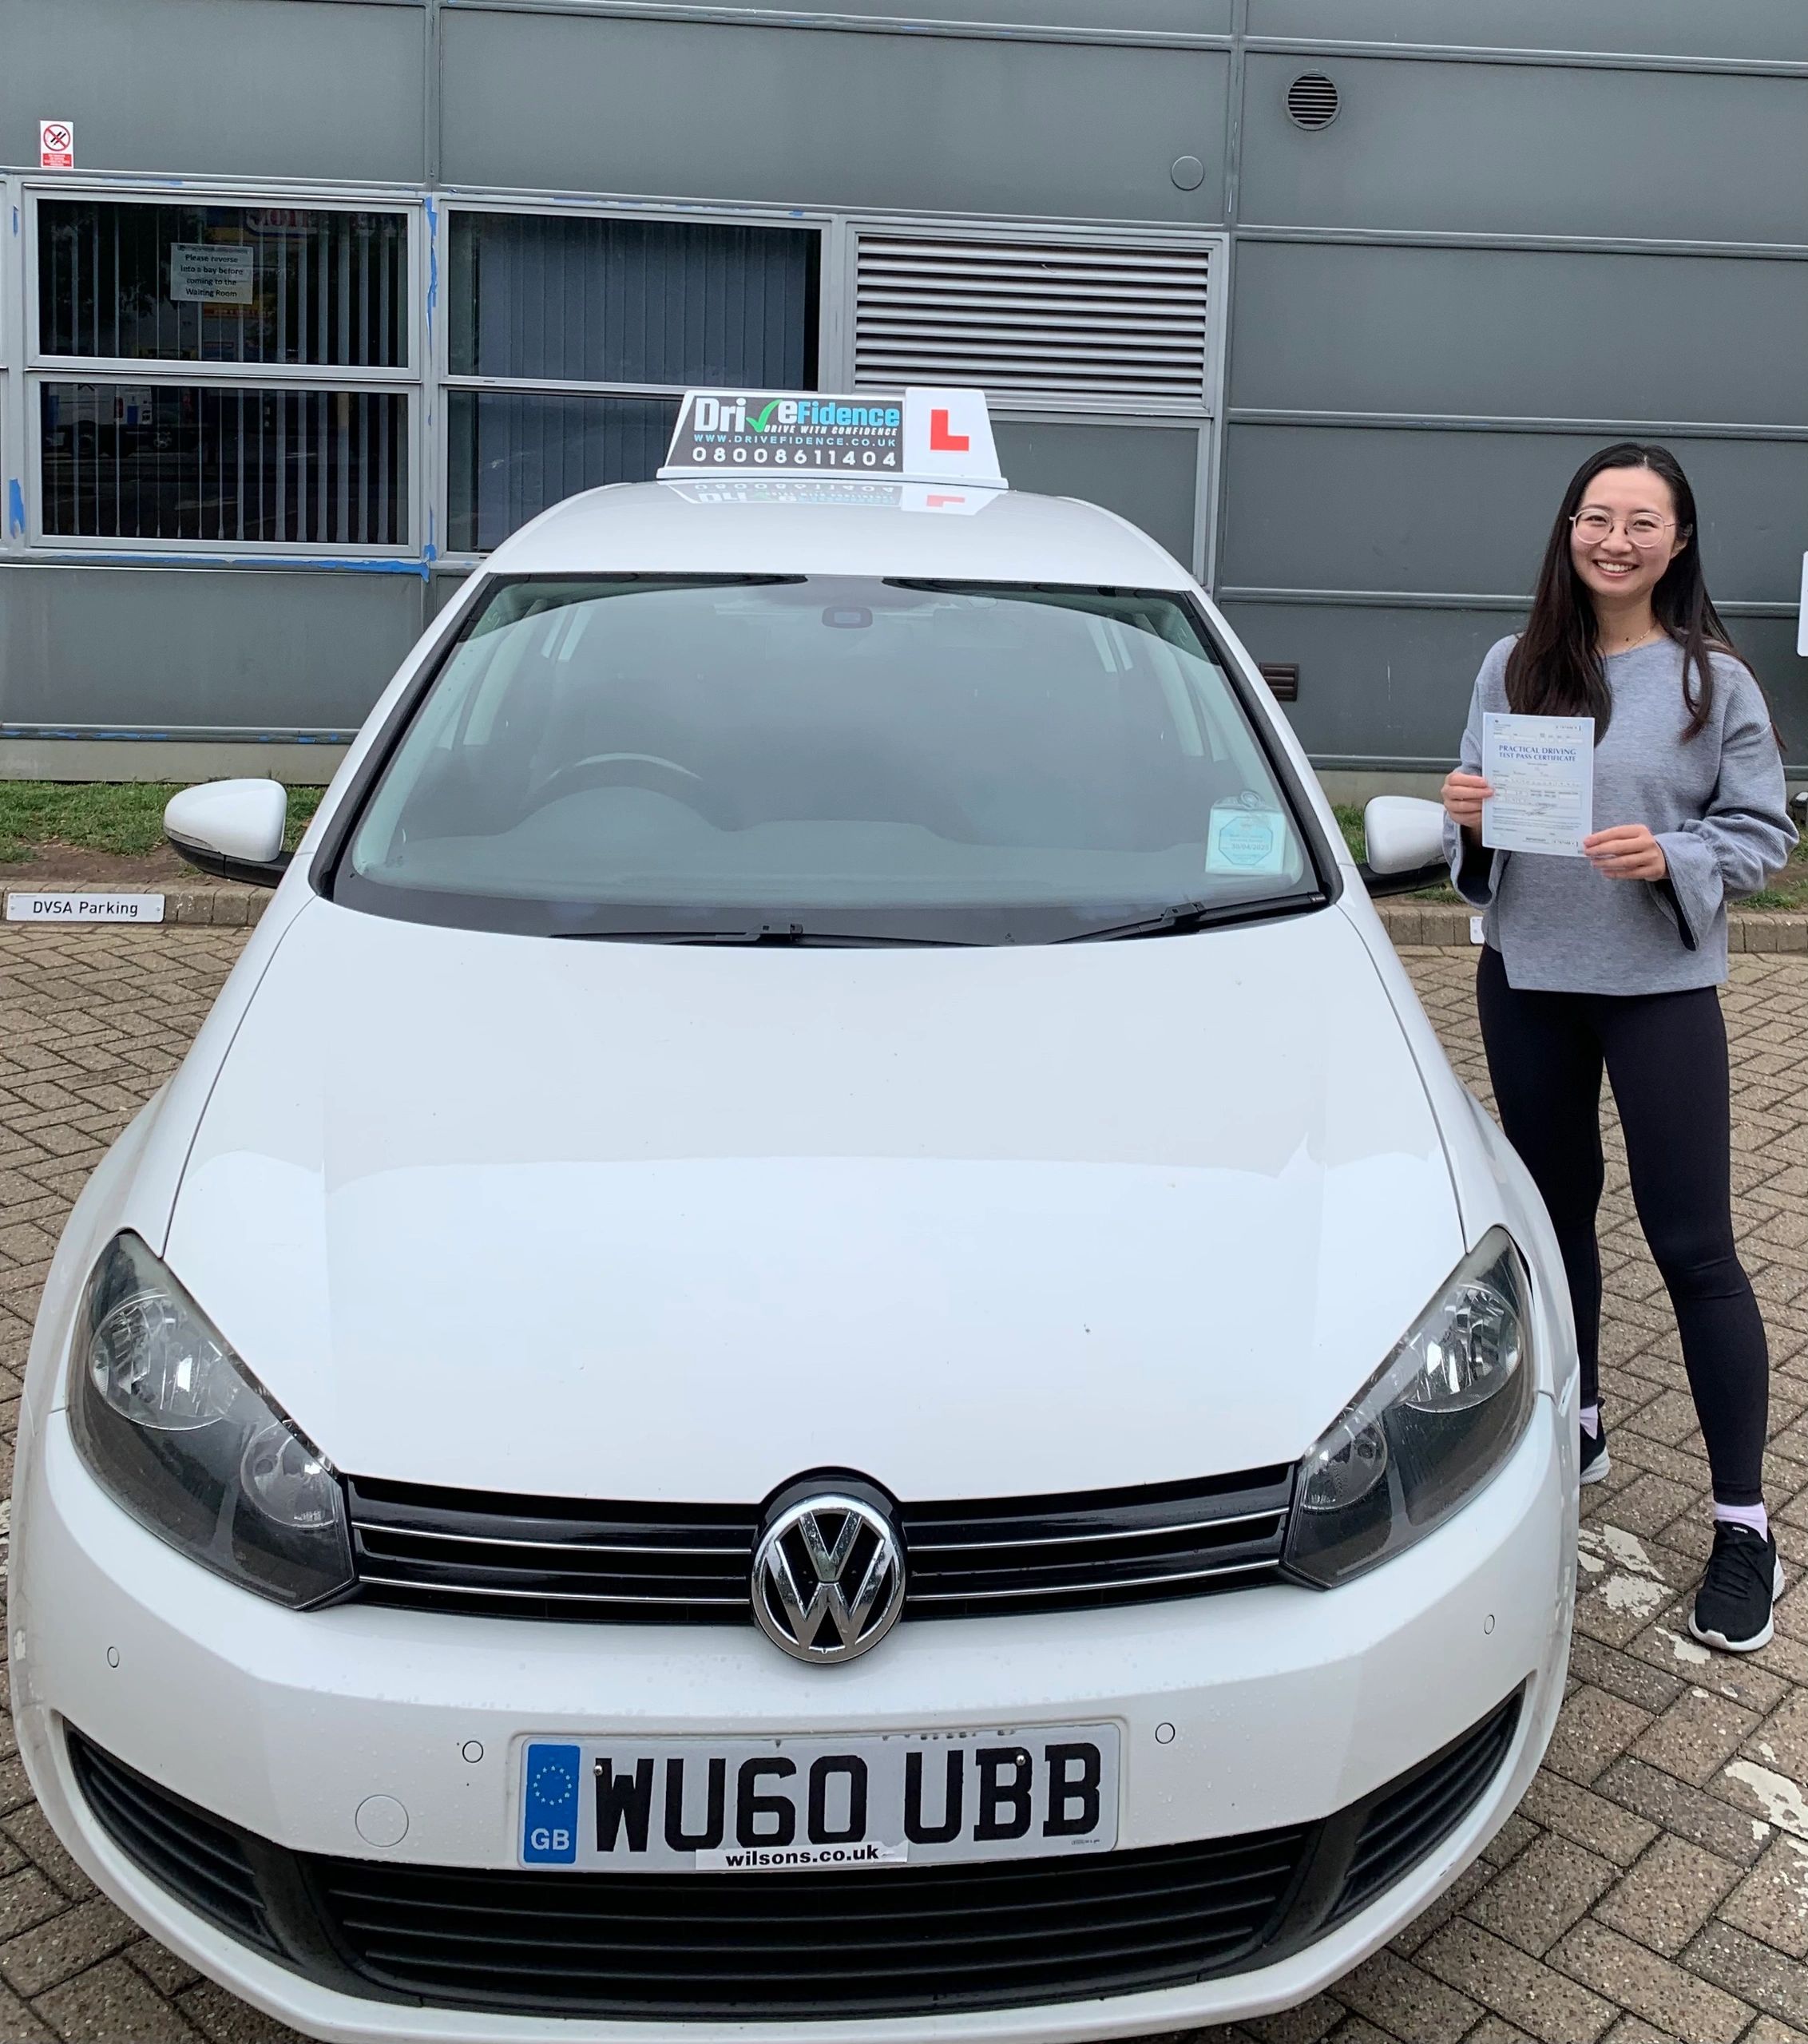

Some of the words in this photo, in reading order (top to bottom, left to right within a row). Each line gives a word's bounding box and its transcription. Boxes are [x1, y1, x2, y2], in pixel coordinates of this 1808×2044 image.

[184, 254, 209, 263] Please
[218, 267, 244, 275] before
[185, 288, 214, 297] Waiting
[764, 425, 796, 434] DRIVE
[800, 426, 827, 434] WITH
[831, 426, 898, 436] CONFIDENCE
[930, 409, 969, 452] L
[694, 434, 895, 447] WWW.DRIVEFIDENCE.CO.UK
[692, 446, 896, 466] 08008611404
[1499, 744, 1539, 754] PRACTICAL
[33, 901, 73, 914] DVSA
[78, 901, 138, 917] Parking
[530, 1828, 570, 1851] GB
[593, 1755, 868, 1853] WU60
[904, 1742, 1101, 1844] UBB
[726, 1844, 879, 1867] wilsons.co.uk
